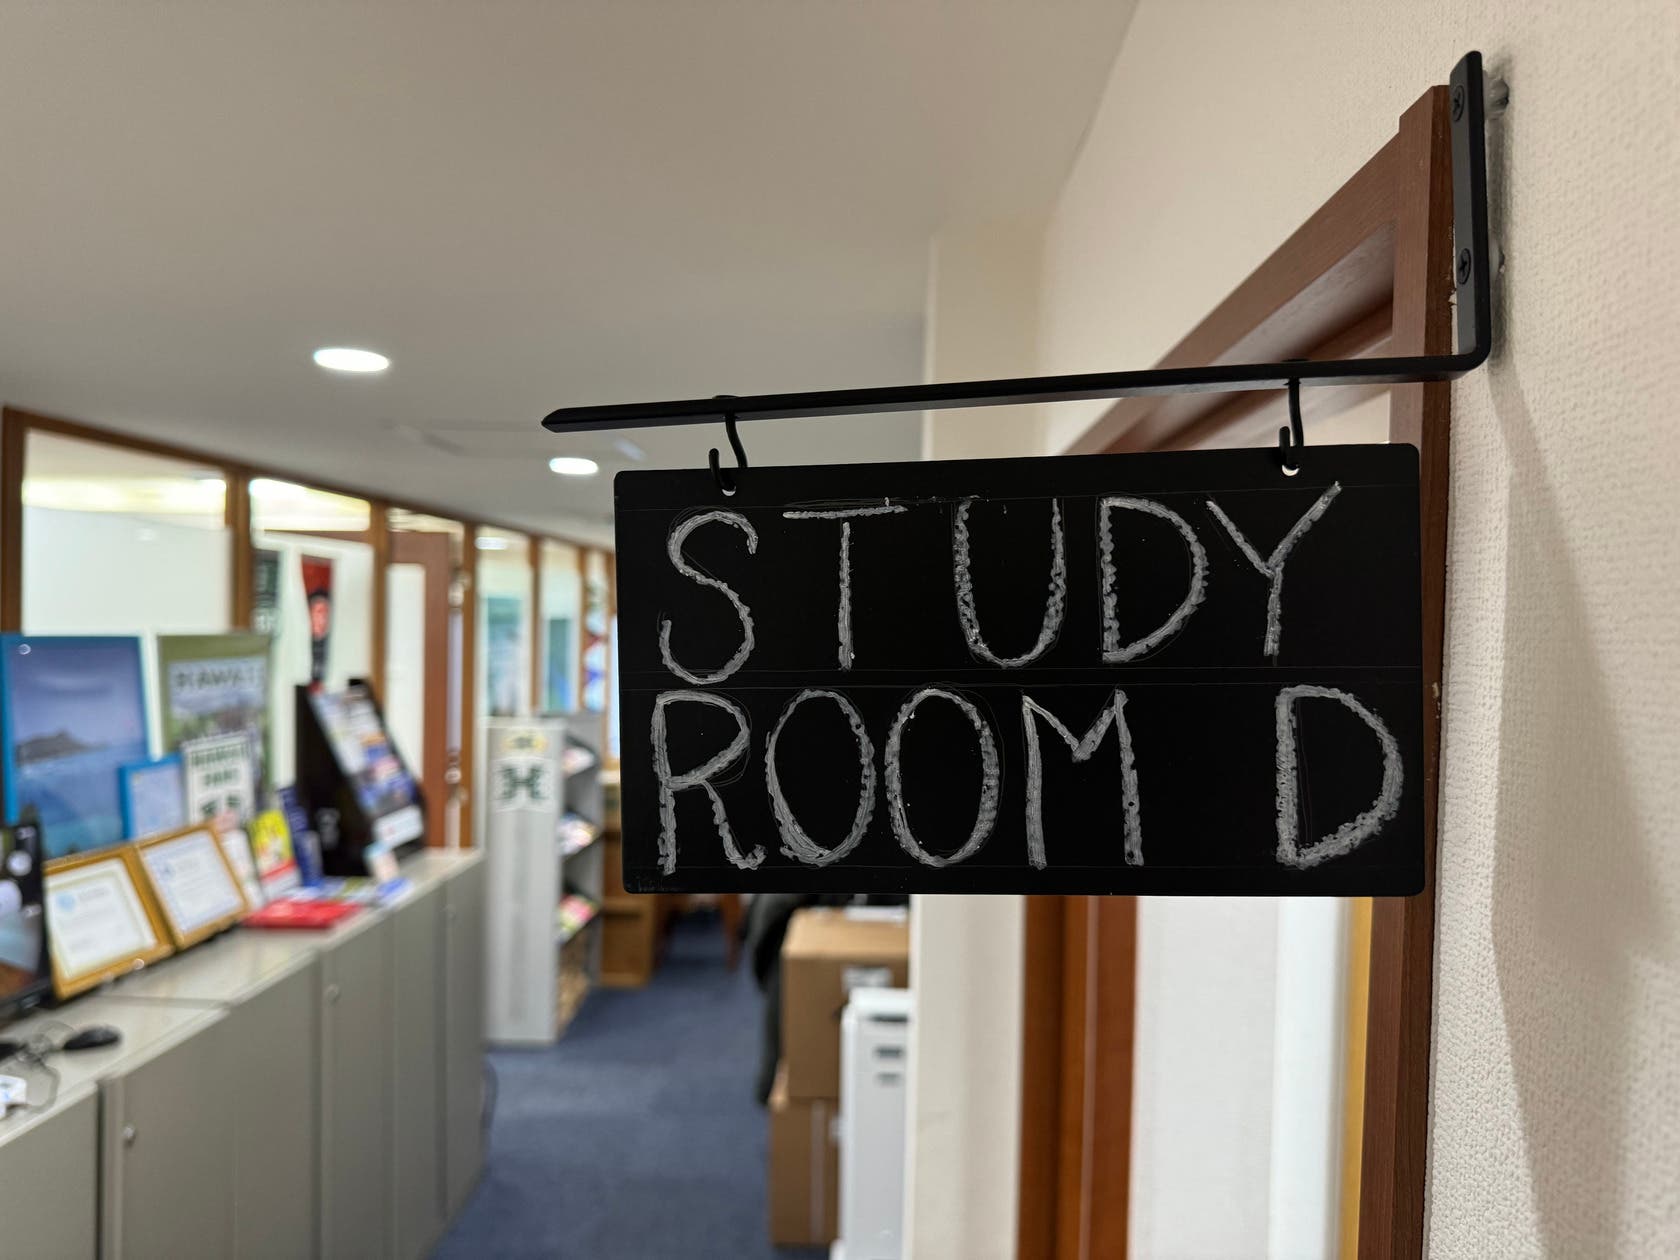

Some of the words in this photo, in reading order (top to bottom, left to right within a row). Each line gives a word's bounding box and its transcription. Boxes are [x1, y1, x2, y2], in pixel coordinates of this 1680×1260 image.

[660, 481, 1341, 683] STUDY
[652, 687, 1144, 874] ROOM
[1276, 685, 1402, 868] D
